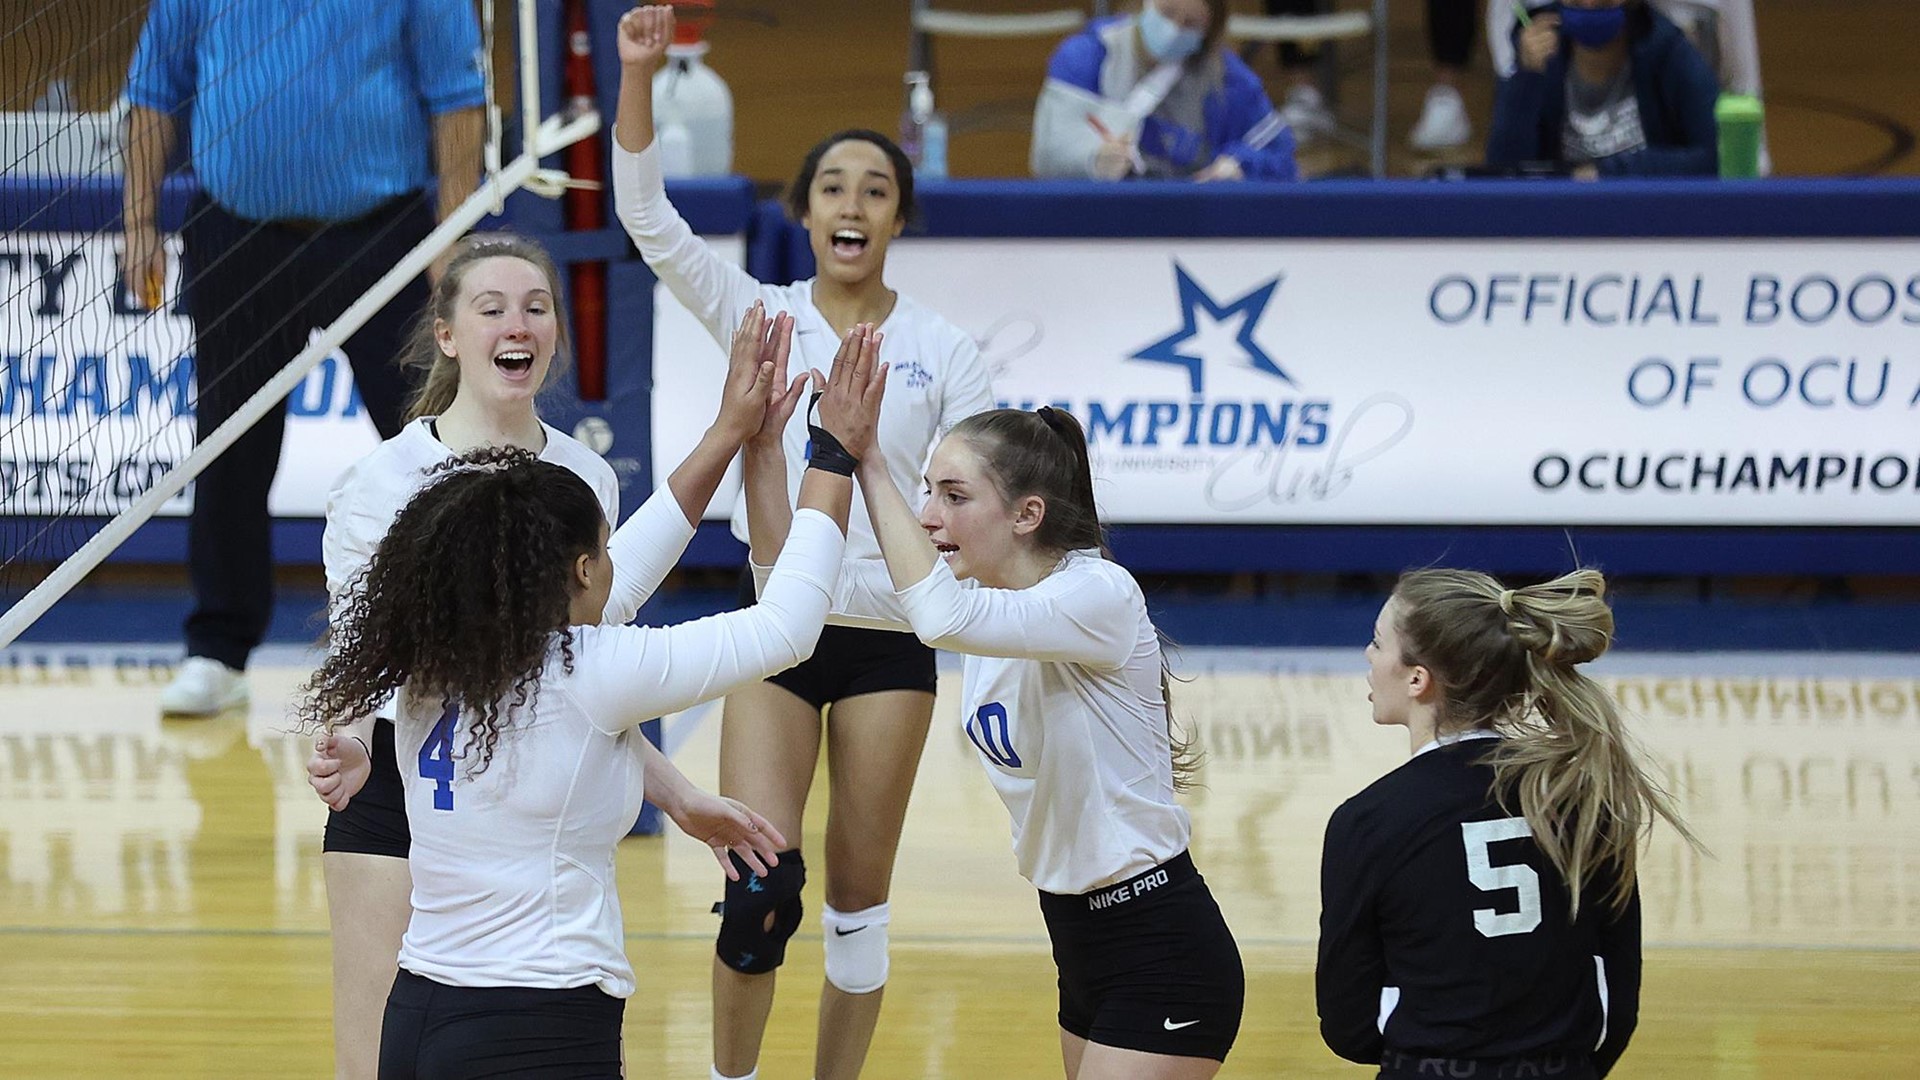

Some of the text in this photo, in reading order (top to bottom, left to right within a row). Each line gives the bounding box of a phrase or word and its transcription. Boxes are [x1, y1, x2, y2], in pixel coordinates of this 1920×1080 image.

[1428, 273, 1721, 326] OFFICIAL
[1628, 357, 1722, 408] OF
[1742, 357, 1891, 408] OCU
[996, 396, 1330, 446] MPIONS
[1532, 454, 1920, 490] OCUCHAMPIO
[418, 702, 456, 811] 4
[1088, 869, 1170, 911] NIKE PRO
[1461, 816, 1542, 938] 5
